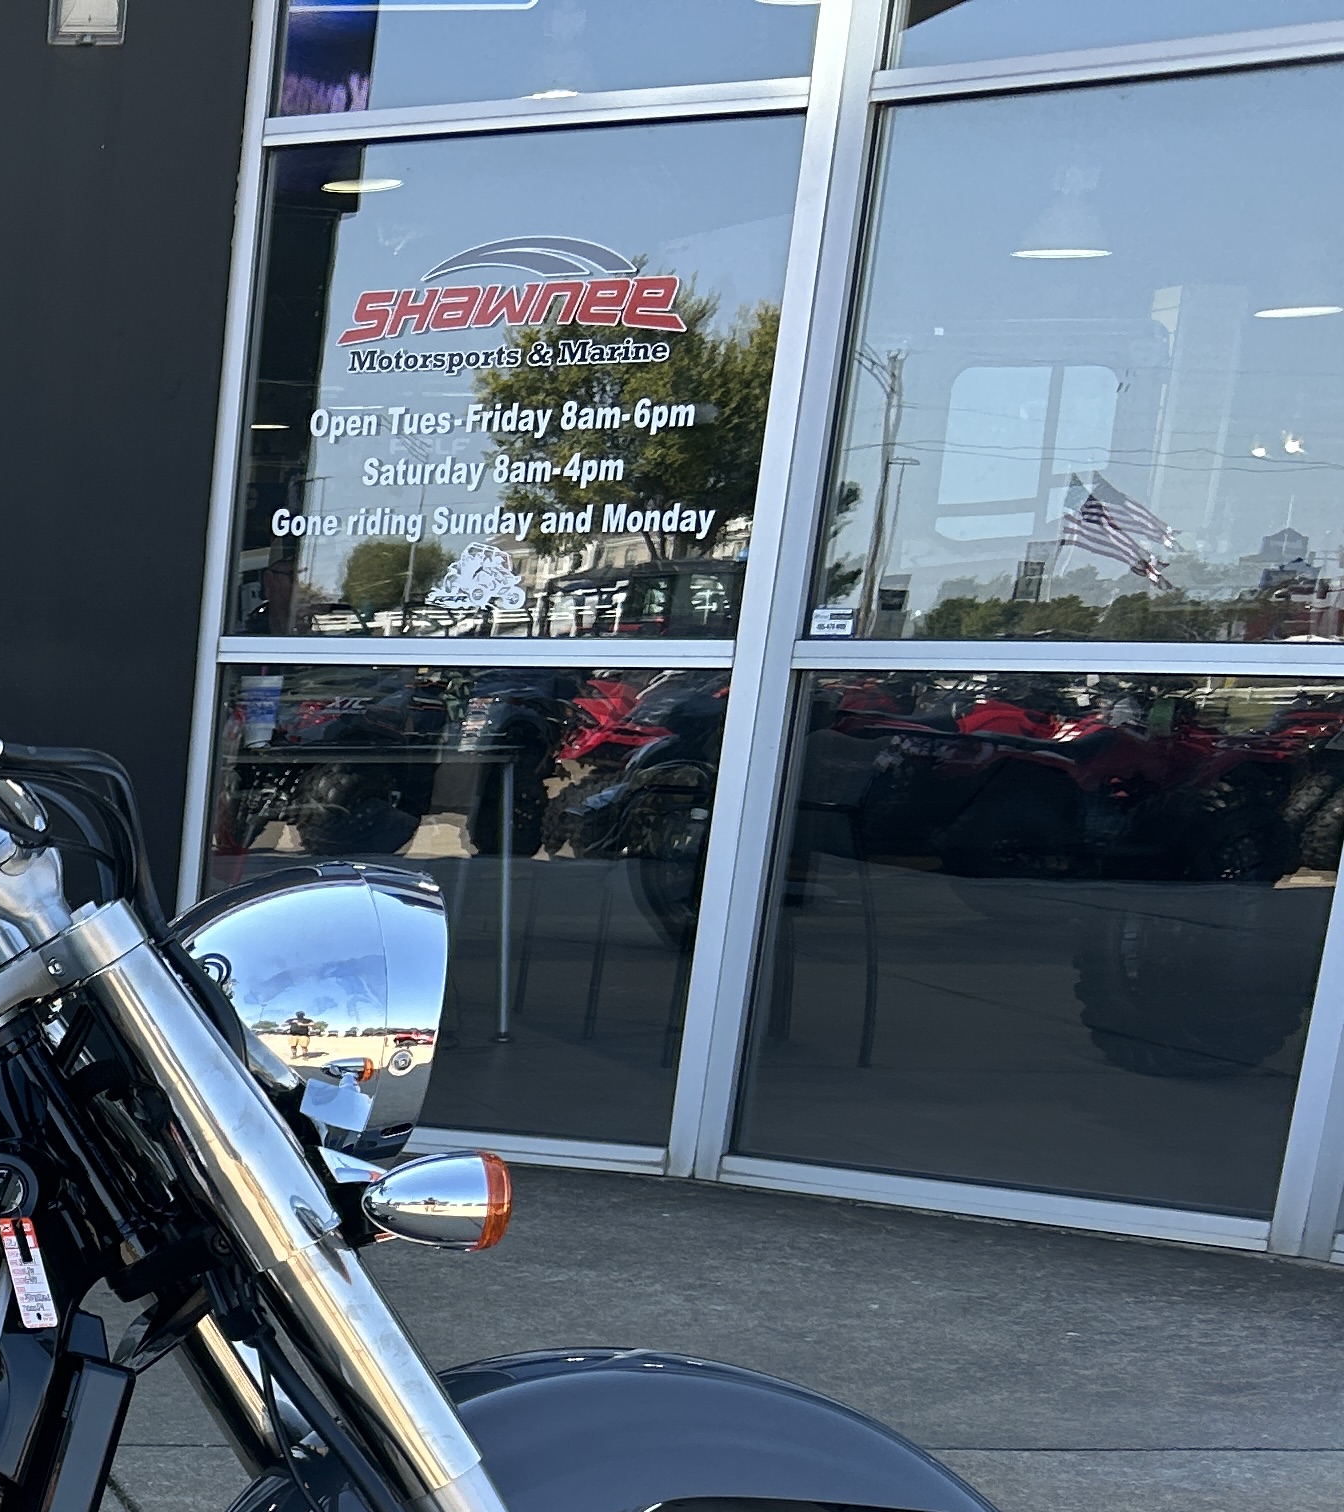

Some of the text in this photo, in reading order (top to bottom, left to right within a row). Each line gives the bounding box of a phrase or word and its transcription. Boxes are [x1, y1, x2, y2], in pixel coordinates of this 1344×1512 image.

[348, 338, 669, 375] Motorsports & Marine
[310, 398, 695, 443] Open Tues-Friday 8am-6pm
[362, 452, 624, 491] Saturday 8am-4pm
[271, 502, 716, 541] Gone riding Sunday and Monday
